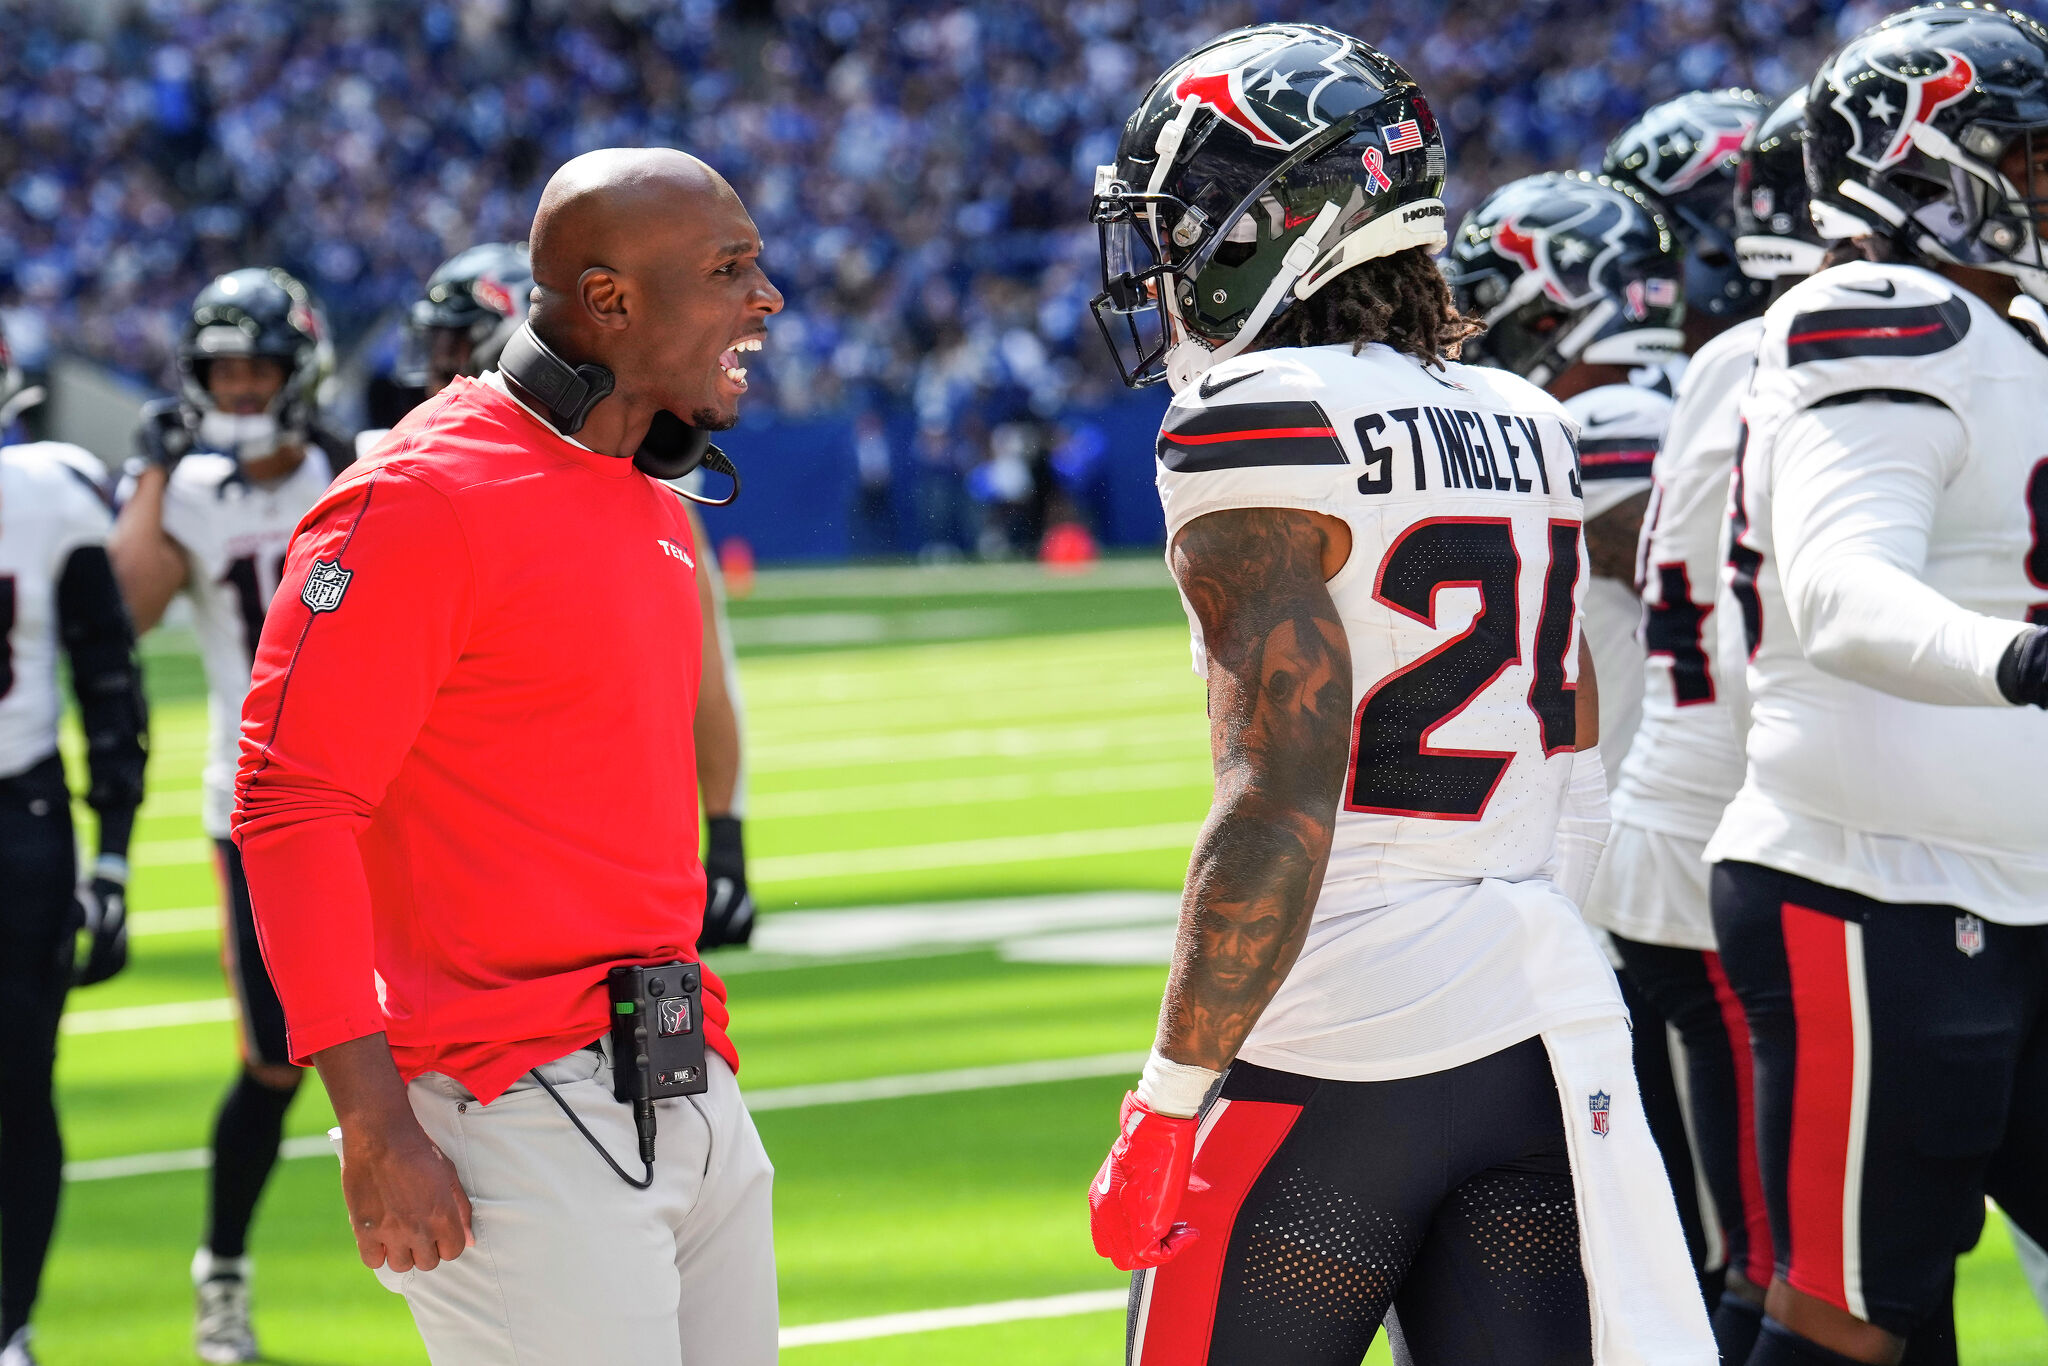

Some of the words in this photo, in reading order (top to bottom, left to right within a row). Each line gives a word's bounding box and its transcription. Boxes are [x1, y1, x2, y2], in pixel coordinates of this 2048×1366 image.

[1369, 164, 1382, 179] 9/11
[1354, 406, 1550, 496] STINGLEY
[305, 579, 341, 606] NFL
[1344, 516, 1582, 822] 24
